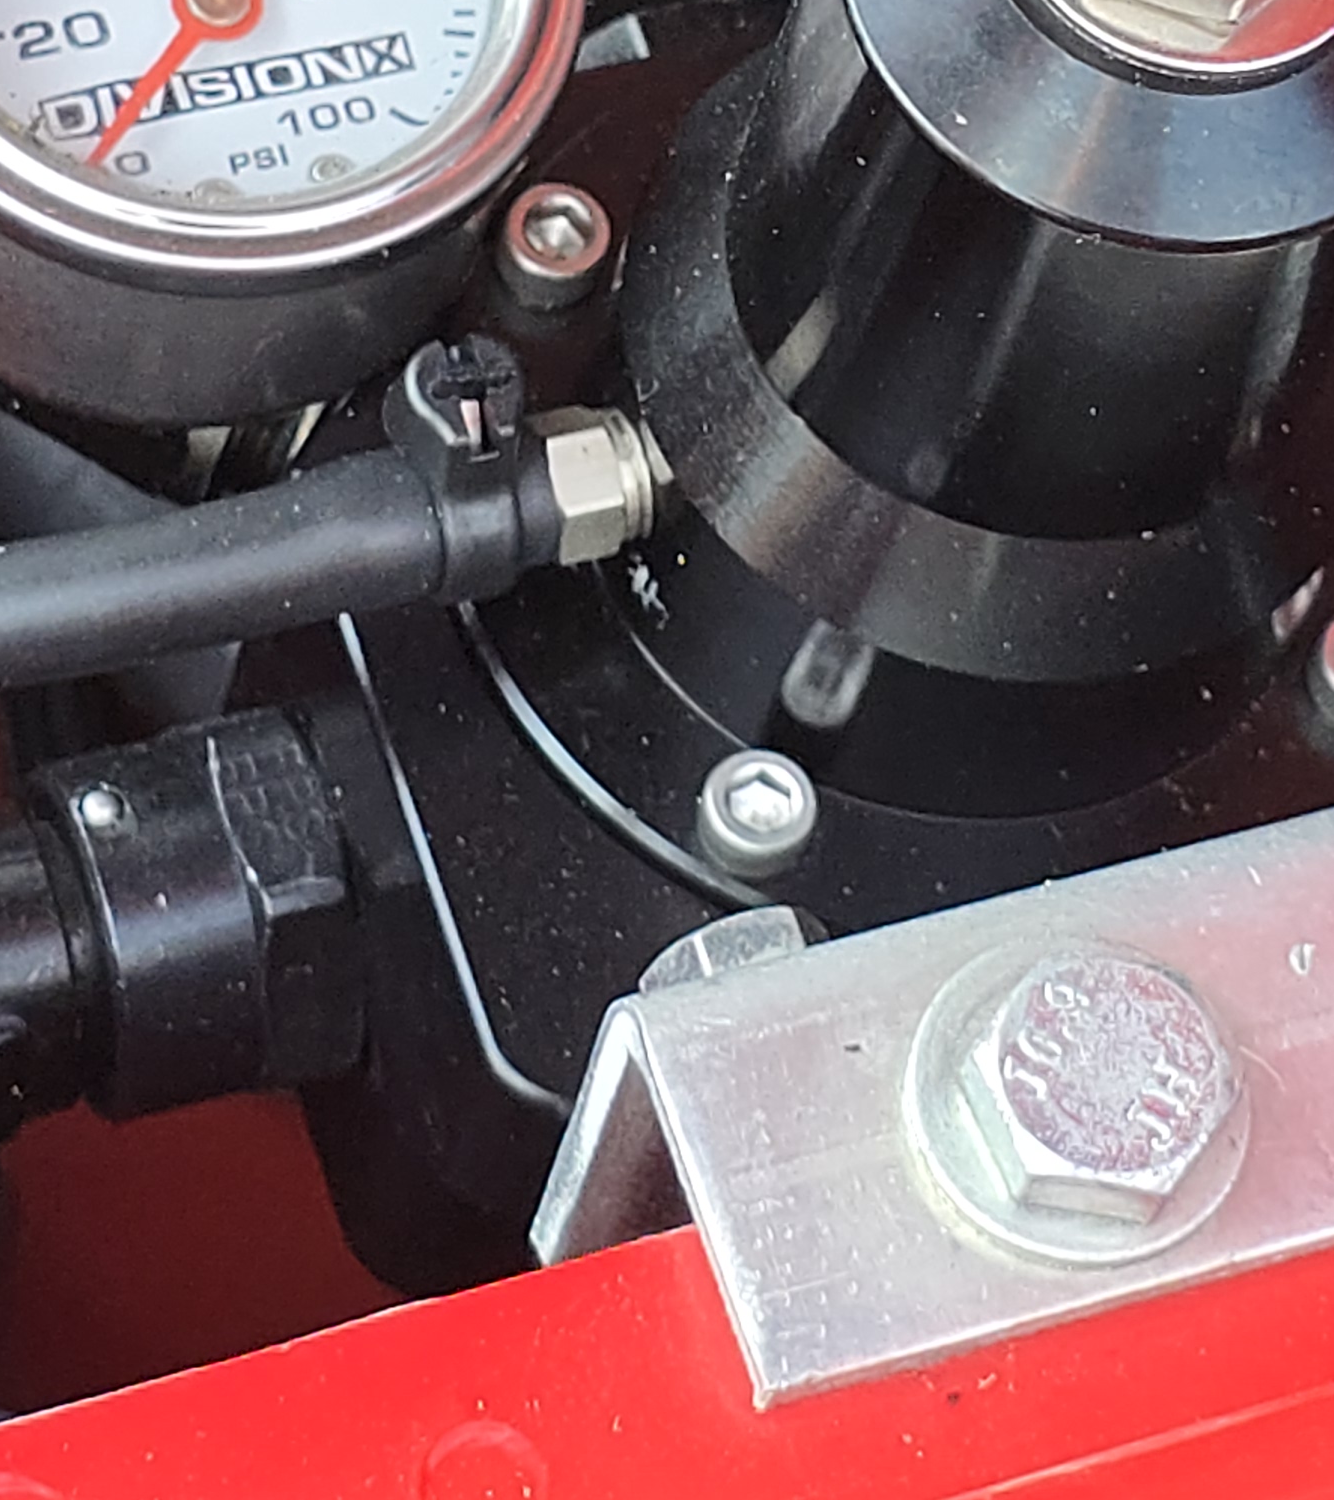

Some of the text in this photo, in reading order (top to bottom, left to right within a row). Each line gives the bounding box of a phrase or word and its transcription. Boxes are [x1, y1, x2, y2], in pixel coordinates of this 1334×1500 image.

[12, 10, 112, 61] 20
[41, 33, 414, 140] DIVISIONX
[277, 96, 376, 137] 100
[115, 150, 151, 176] 0
[228, 143, 290, 176] PSI
